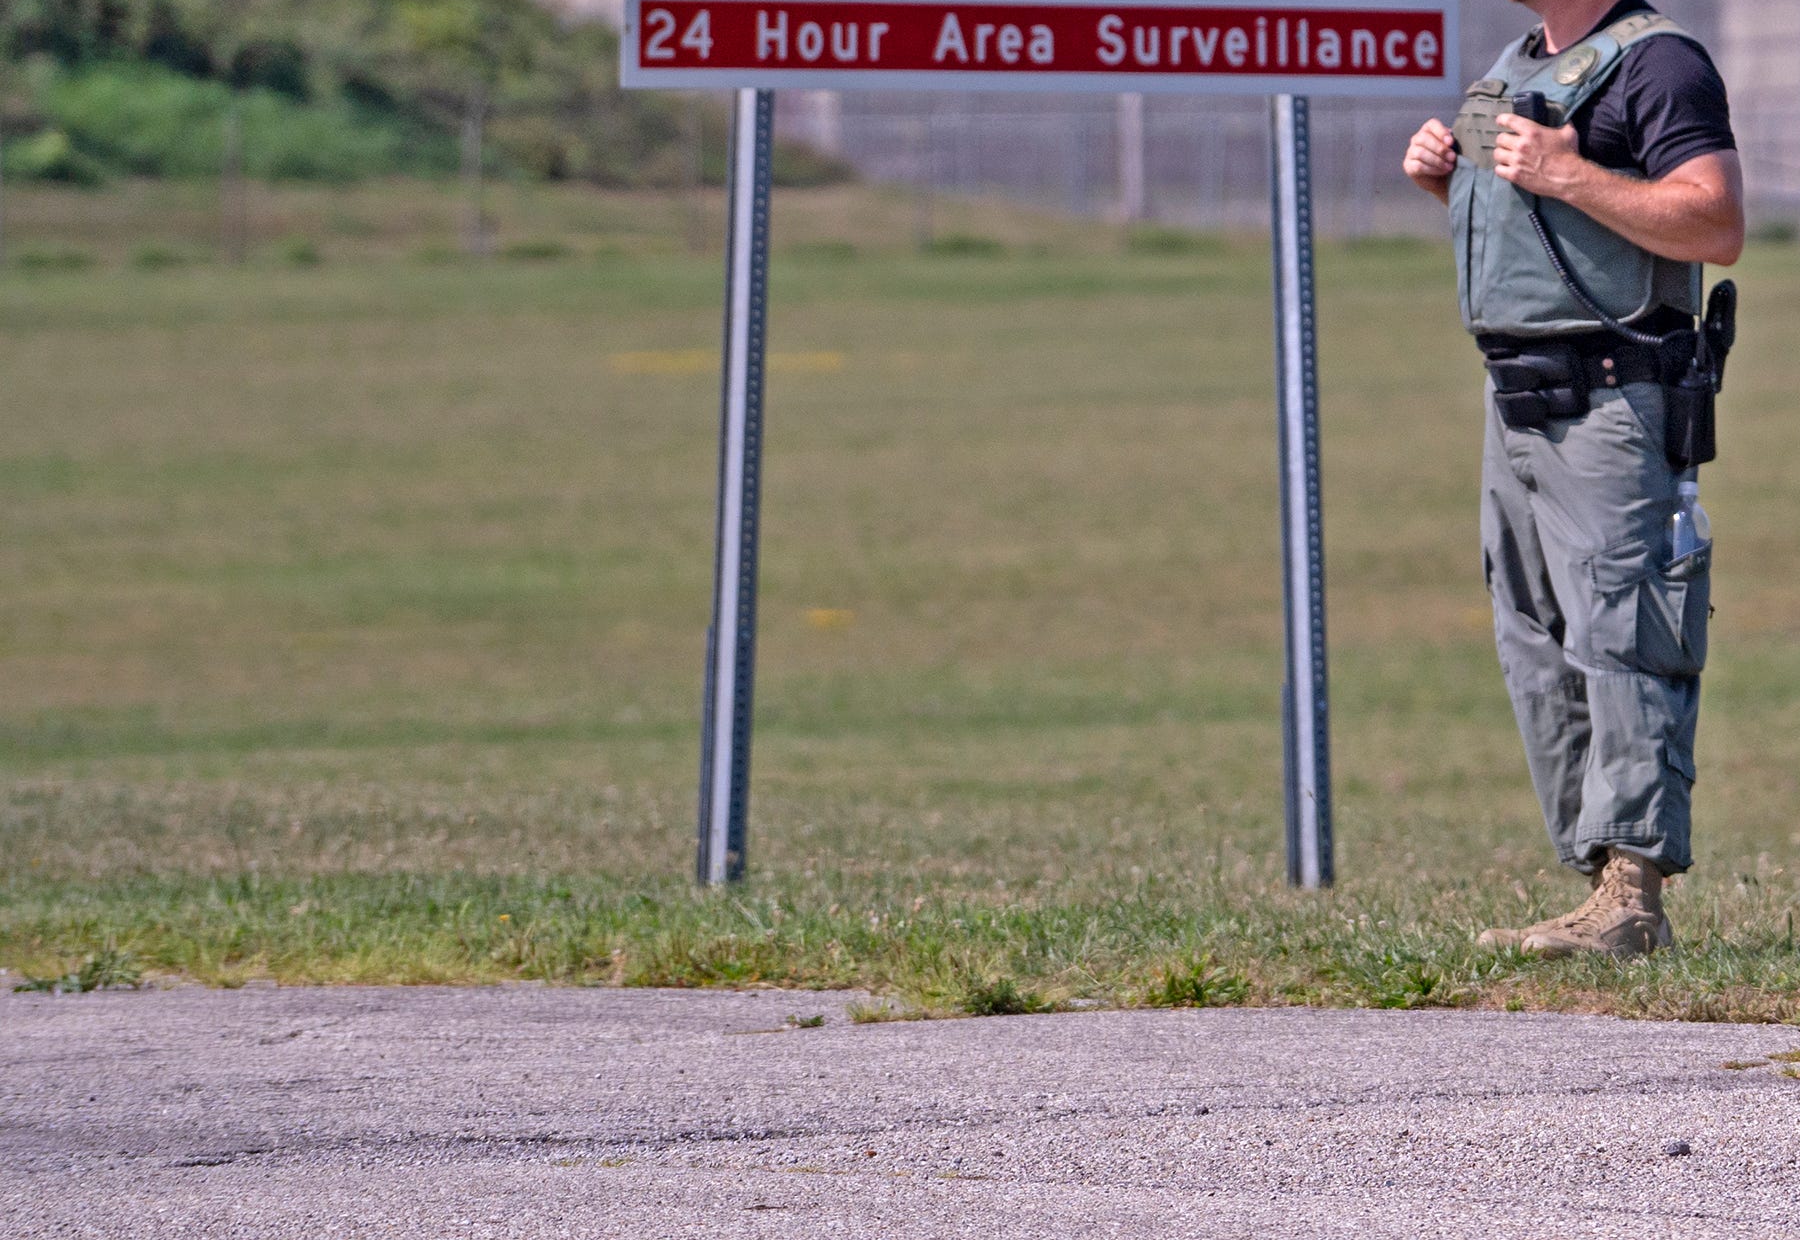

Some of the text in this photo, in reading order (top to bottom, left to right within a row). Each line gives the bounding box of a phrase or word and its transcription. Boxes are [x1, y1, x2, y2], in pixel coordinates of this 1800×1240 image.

[645, 8, 1438, 68] 24 Hour Area Surveillance
